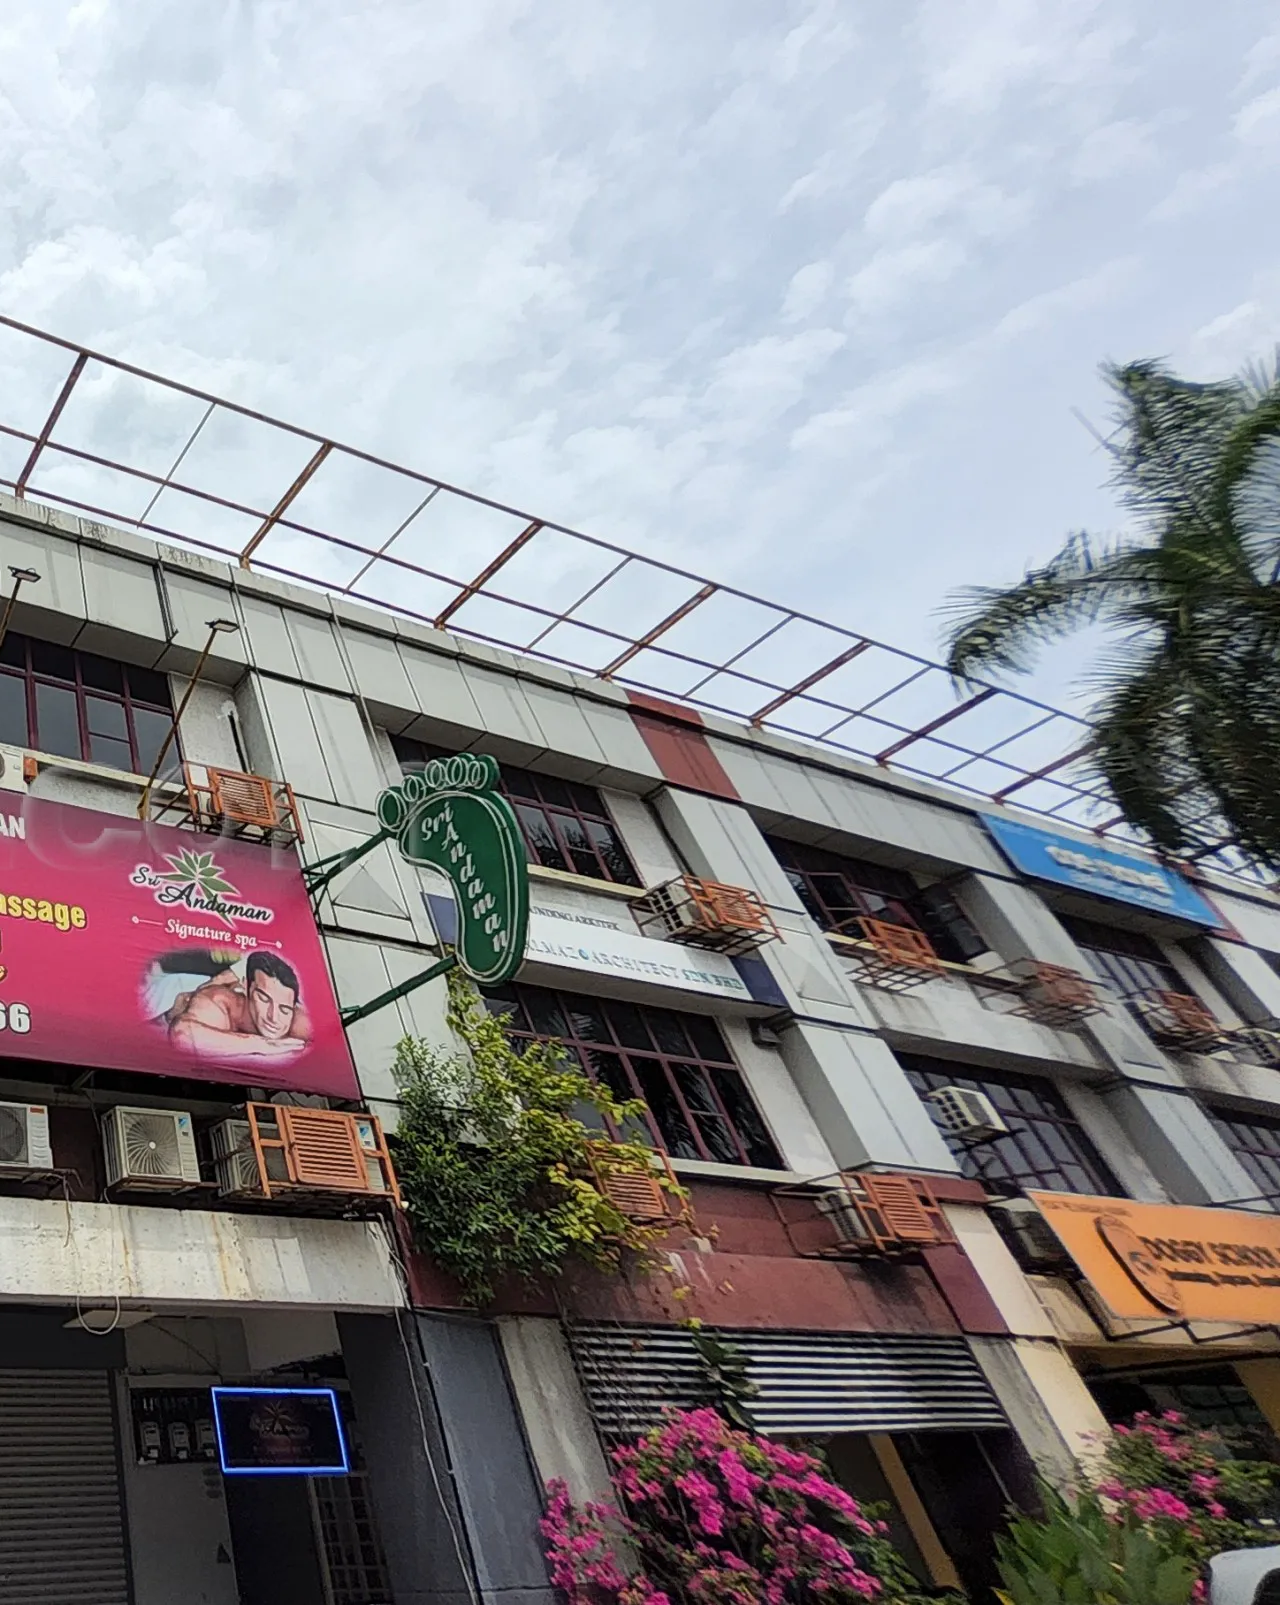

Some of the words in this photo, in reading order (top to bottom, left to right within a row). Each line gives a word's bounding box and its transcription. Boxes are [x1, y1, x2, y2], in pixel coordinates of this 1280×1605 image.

[422, 802, 454, 841] Sri
[132, 866, 161, 887] Sri
[157, 882, 272, 922] Andaman
[441, 821, 510, 952] Andaman
[528, 904, 574, 922] UNDING
[164, 918, 232, 942] Signature
[234, 933, 258, 950] spa
